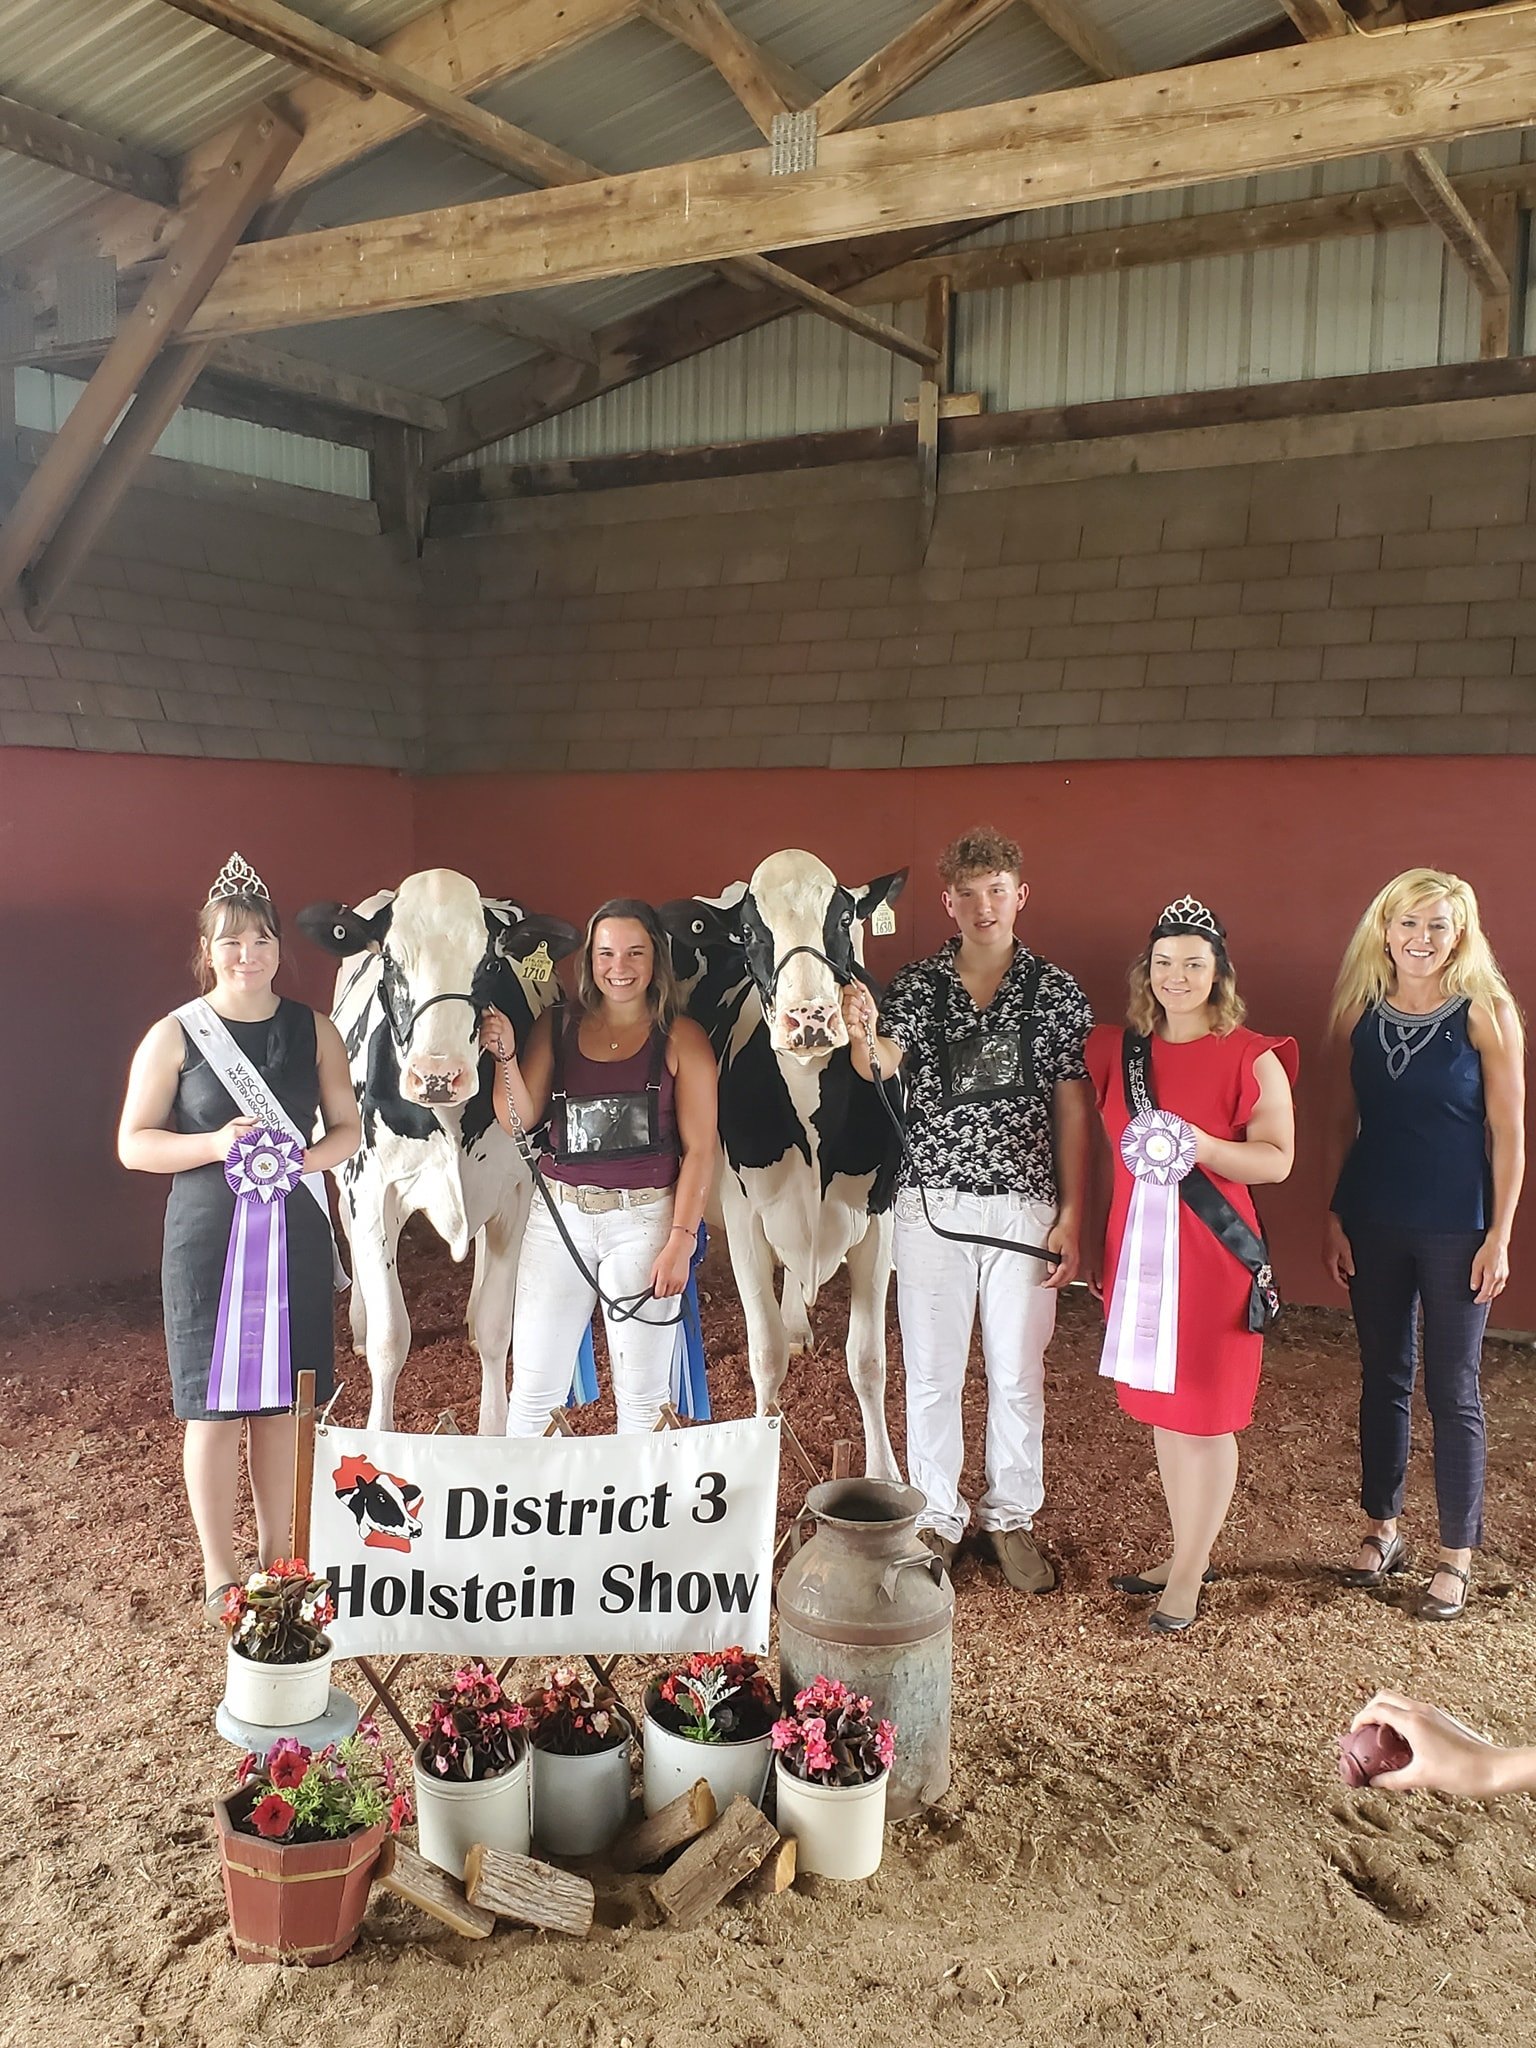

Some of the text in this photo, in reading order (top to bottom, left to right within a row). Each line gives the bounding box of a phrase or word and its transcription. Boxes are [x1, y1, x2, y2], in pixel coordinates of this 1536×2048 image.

[522, 966, 546, 981] 1710
[225, 1067, 250, 1099] HOLSTEIN
[235, 1062, 286, 1132] WISCONSIN
[444, 1471, 729, 1540] District 3
[325, 1560, 760, 1624] Holstein Show
